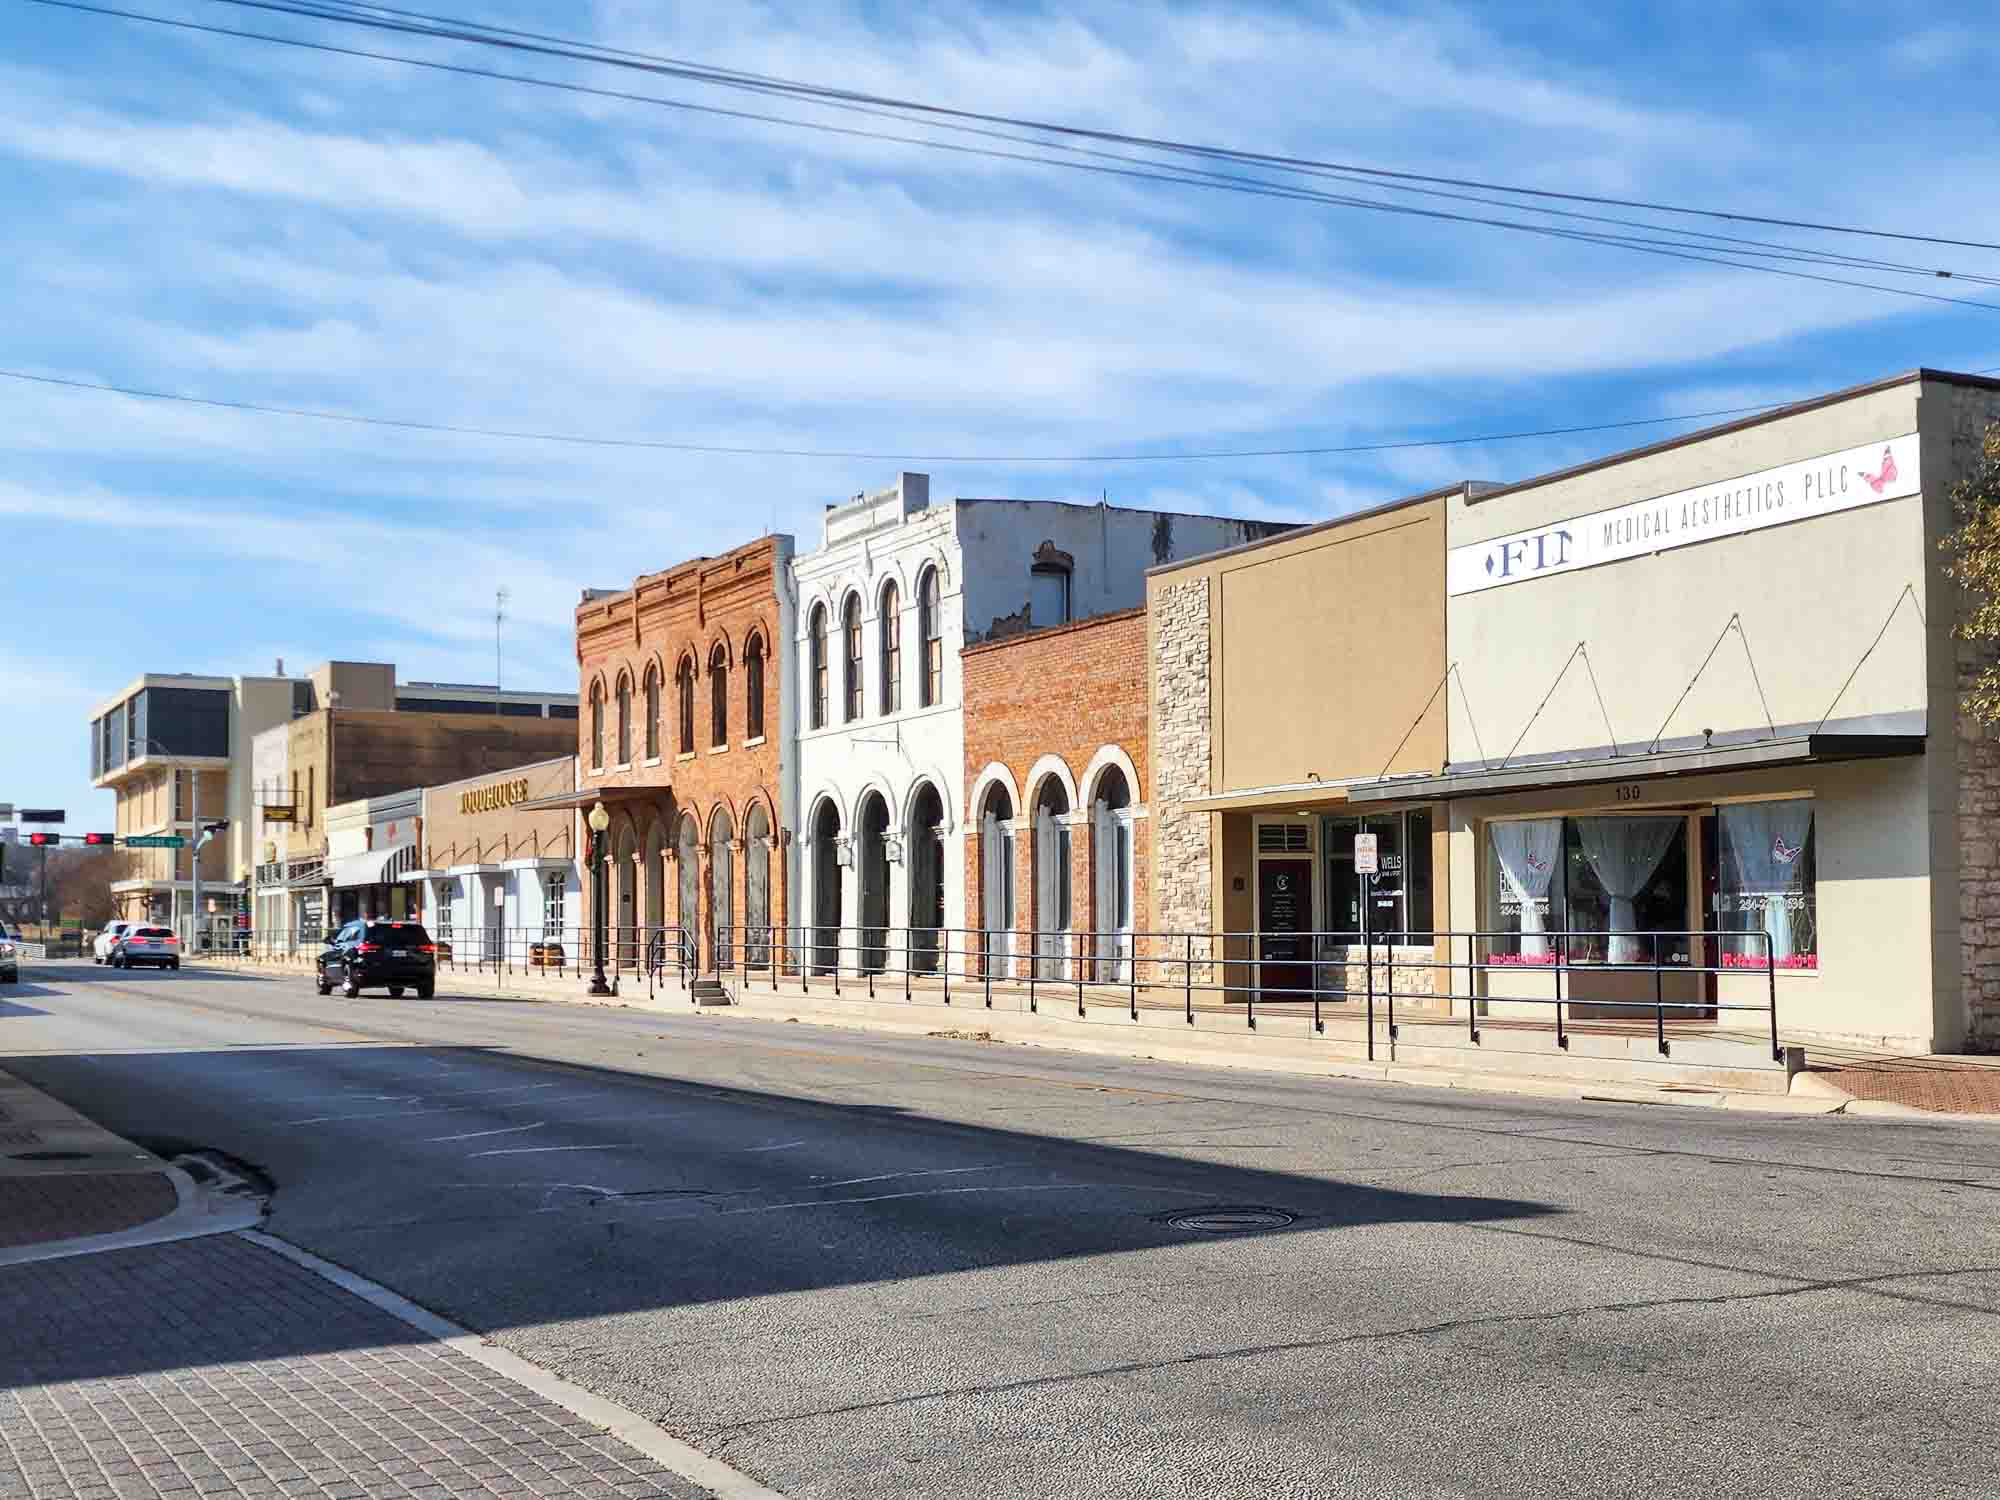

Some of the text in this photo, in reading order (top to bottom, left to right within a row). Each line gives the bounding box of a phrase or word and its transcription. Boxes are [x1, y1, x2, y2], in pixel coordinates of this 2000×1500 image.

[1604, 507, 1671, 548] MEDICAL
[1805, 465, 1848, 505] PLLC
[1615, 784, 1641, 801] 130
[1381, 855, 1402, 869] WELLS
